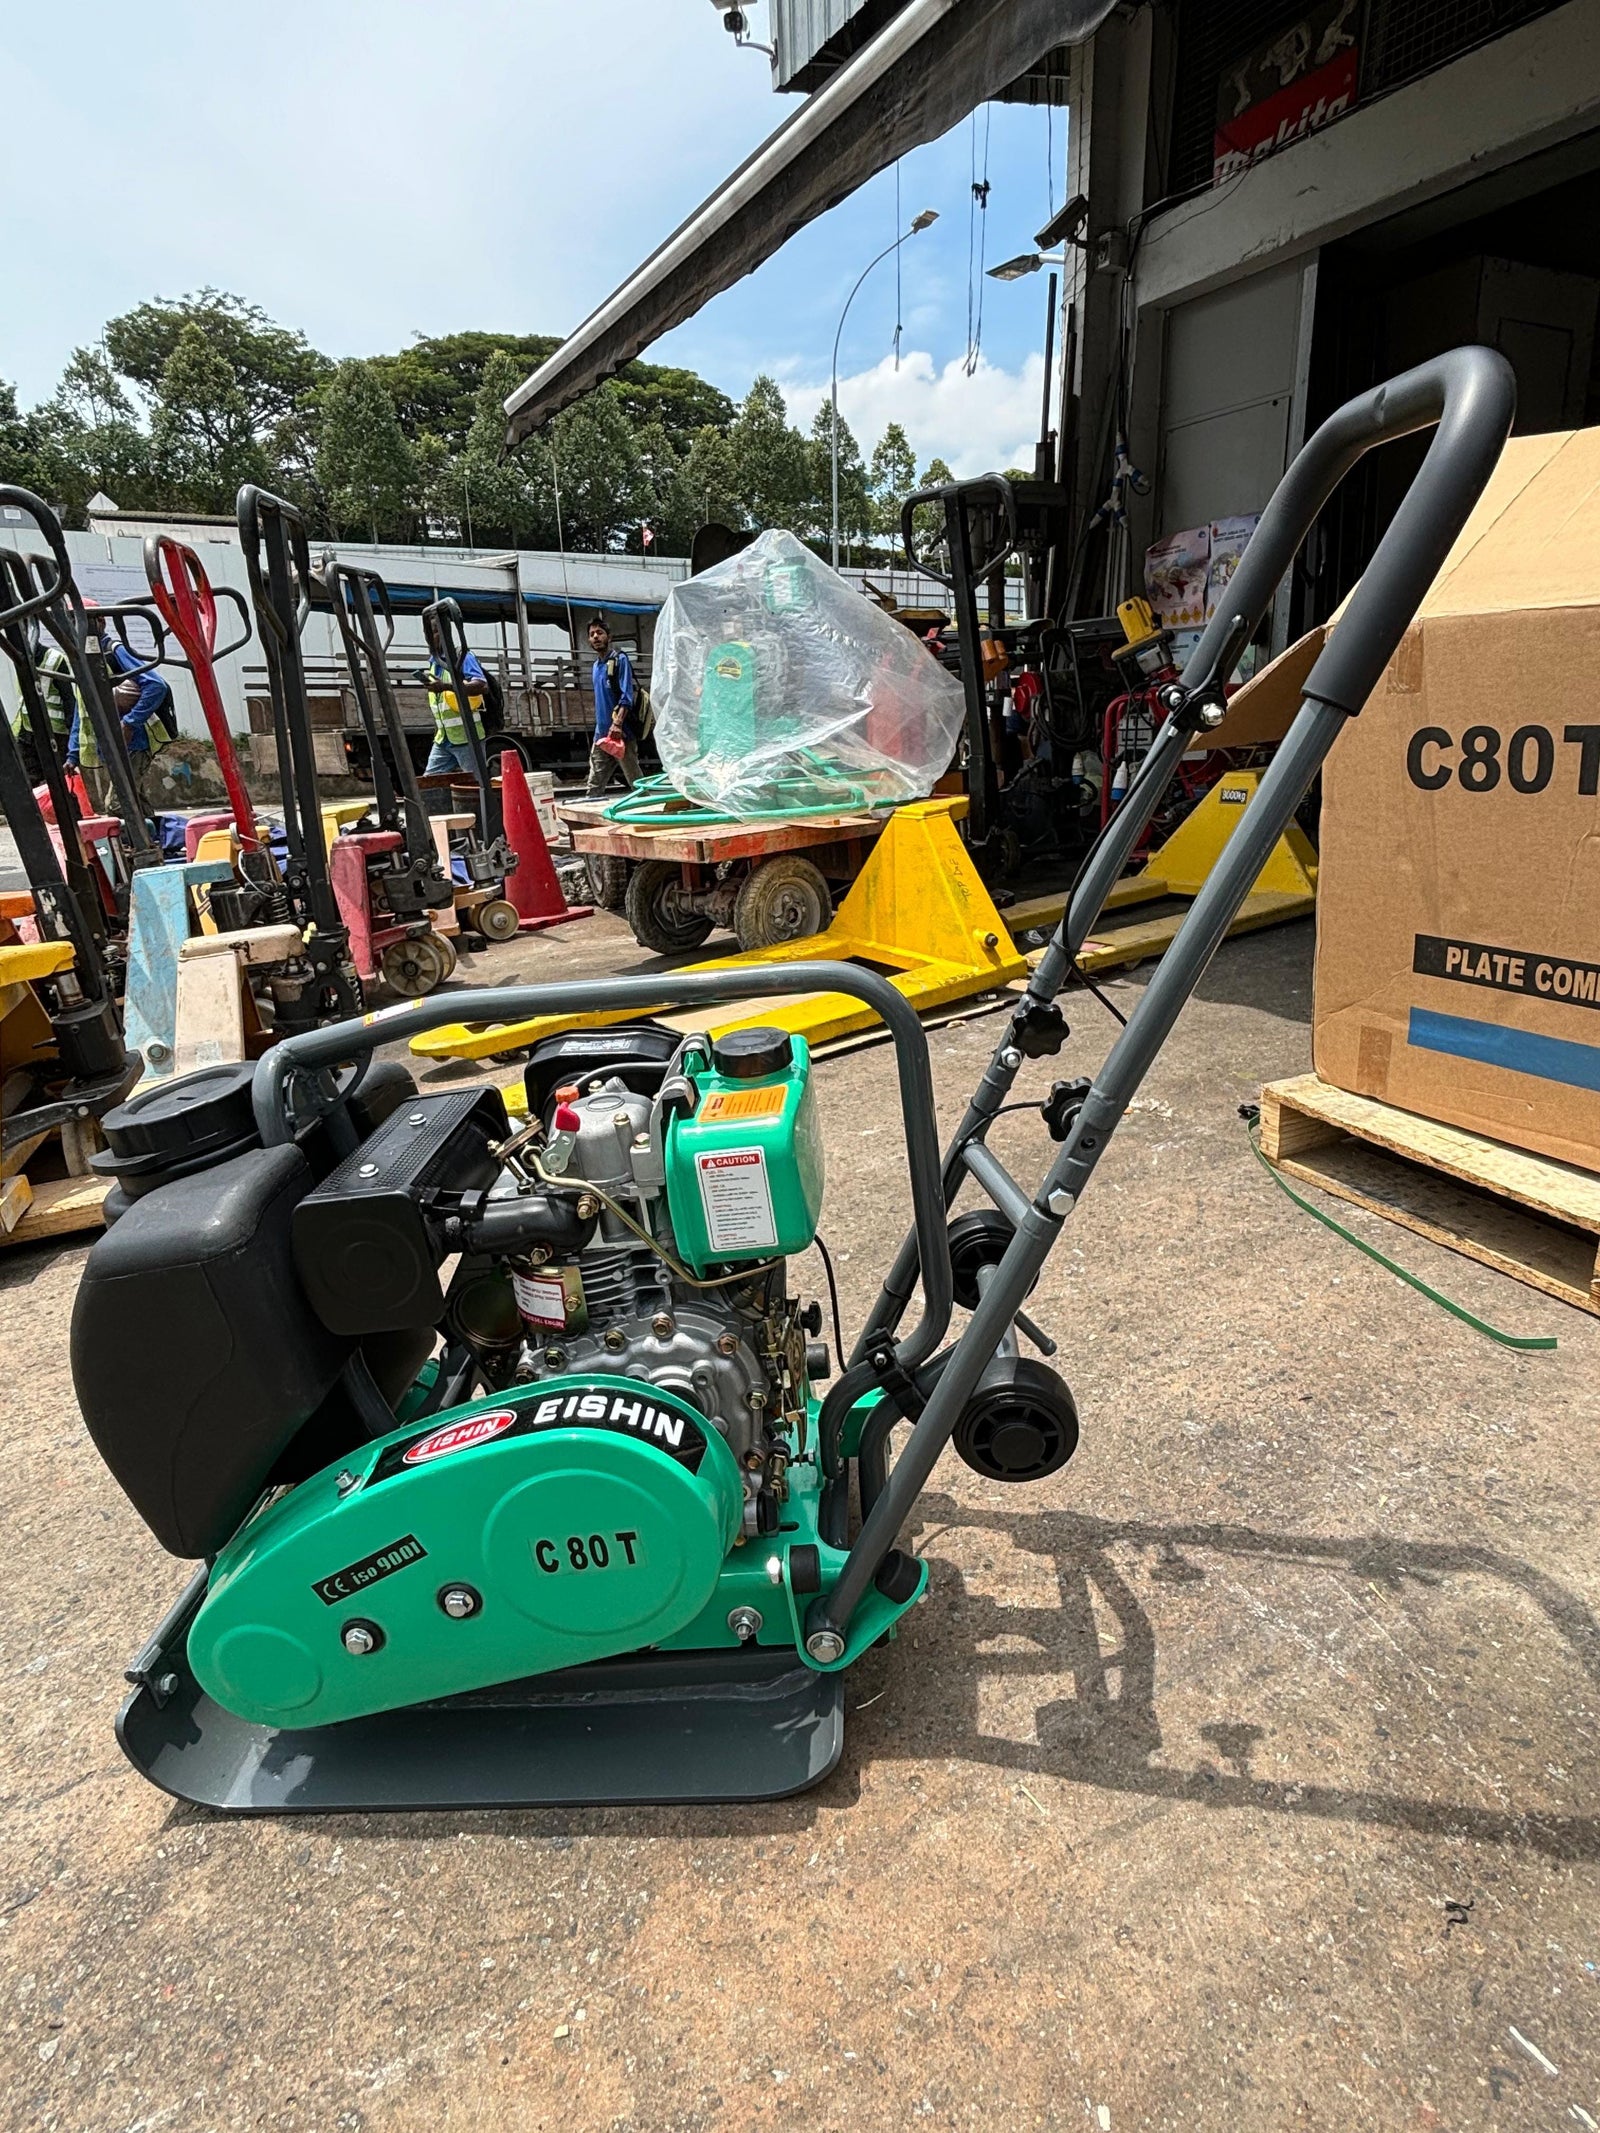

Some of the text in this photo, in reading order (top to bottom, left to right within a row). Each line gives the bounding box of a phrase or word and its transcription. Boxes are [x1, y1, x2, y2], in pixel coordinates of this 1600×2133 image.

[1407, 724, 1600, 795] C80T
[1445, 946, 1600, 1002] PLATE COM
[716, 1155, 756, 1167] CAUTION
[415, 1417, 500, 1456] EISHIN
[533, 1394, 684, 1446] EISHIN
[350, 1566, 378, 1585] iso
[376, 1541, 421, 1572] 9001
[535, 1531, 637, 1573] C 80 T
